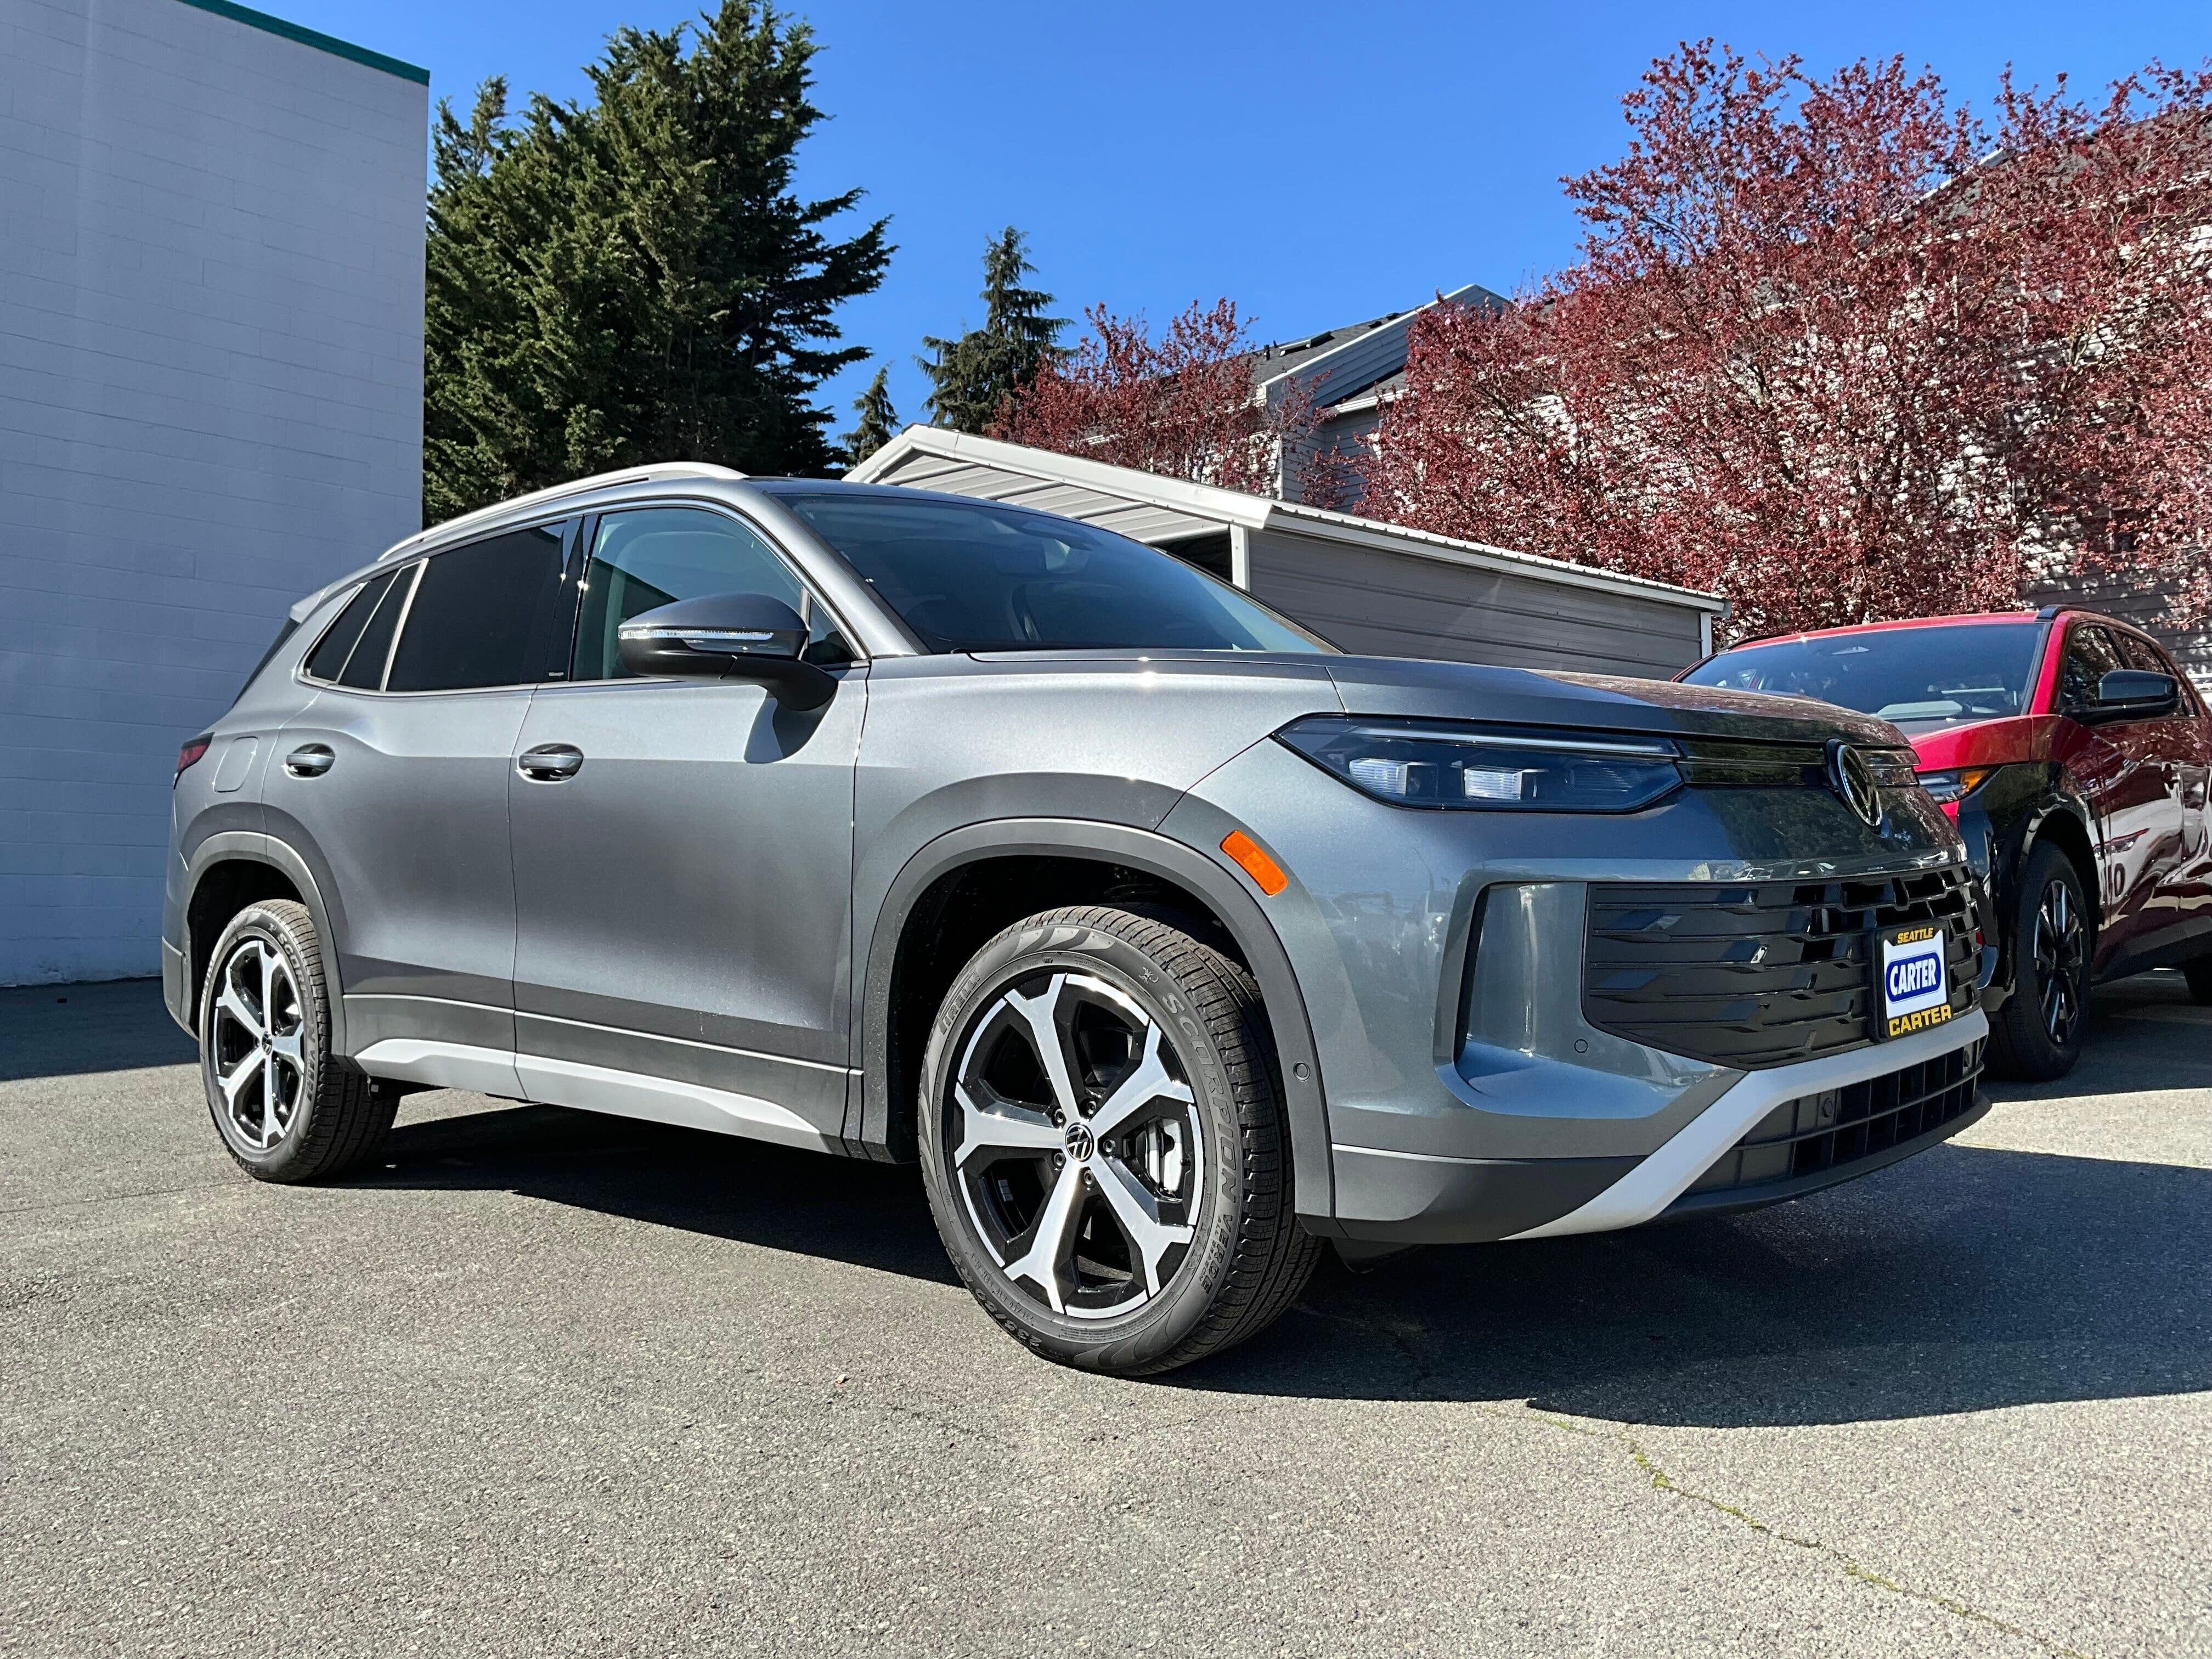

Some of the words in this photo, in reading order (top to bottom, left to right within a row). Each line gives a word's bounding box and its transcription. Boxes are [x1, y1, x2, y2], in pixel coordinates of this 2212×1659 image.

[1897, 927, 1933, 944] SEATTLE
[1889, 957, 1937, 996] CARTER
[1889, 1005, 1952, 1036] CARTER
[1161, 992, 1236, 1203] SCORPION
[1201, 1214, 1233, 1294] VERDE
